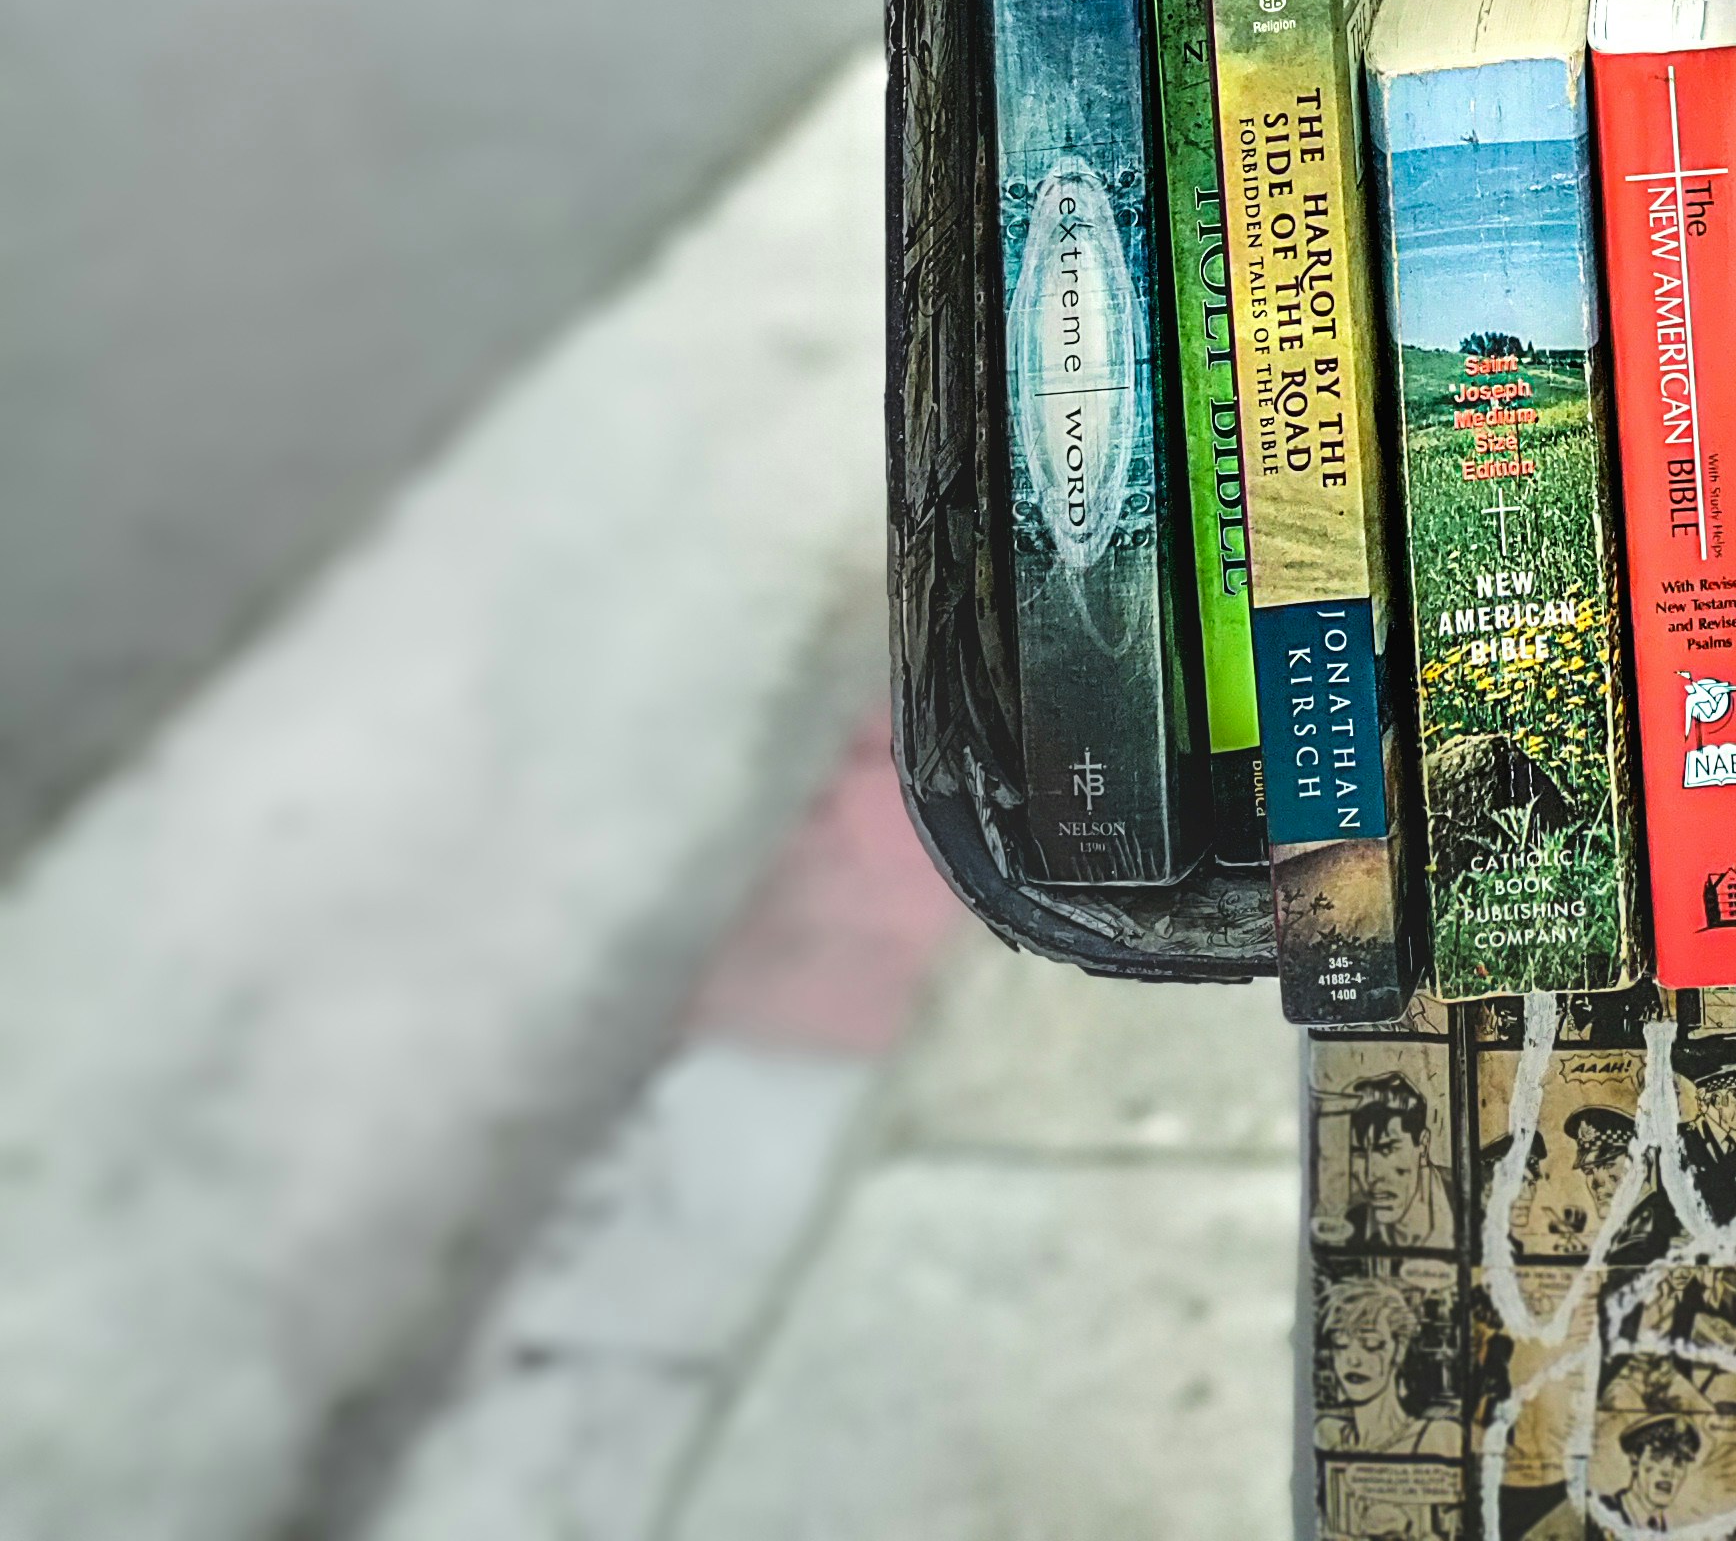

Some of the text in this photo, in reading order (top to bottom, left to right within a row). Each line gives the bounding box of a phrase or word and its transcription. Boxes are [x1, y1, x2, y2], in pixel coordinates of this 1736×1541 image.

[1253, 17, 1296, 35] Religion
[1685, 180, 1715, 237] The
[1239, 117, 1279, 476] FORBIDDEN TALES OF THE BIBLE
[1264, 111, 1313, 473] SIDE OF THE ROAD
[1296, 88, 1346, 488] THE HARLOT BY THE
[1058, 195, 1086, 528] extreme WORD
[1465, 354, 1518, 376] Saint
[1648, 186, 1699, 538] NEW AMERICAN BIBLE
[1454, 380, 1533, 403] Joseph
[1454, 407, 1538, 430] Medium
[1475, 434, 1518, 453] Size
[1462, 458, 1536, 481] Edition
[1708, 453, 1724, 559] With Study Helps
[1477, 572, 1534, 598] NEW
[1661, 579, 1695, 594] With
[1656, 599, 1689, 615] New
[1439, 601, 1577, 637] AMERICAN
[1667, 618, 1694, 632] and
[1471, 636, 1550, 665] BIBLE
[1686, 636, 1732, 651] Psalms
[1288, 647, 1321, 798] KIRSCH
[1317, 609, 1361, 829] JONATHAN
[1059, 822, 1125, 835] NELSON
[1471, 850, 1573, 871] CATHOLIC
[1494, 877, 1555, 895] BOOK
[1465, 902, 1586, 925] PUBLISHING
[1475, 929, 1580, 949] COMPANY
[1329, 956, 1353, 969] 345-
[1318, 972, 1366, 986] 41882-4-
[1330, 988, 1356, 1002] 1400
[1572, 1061, 1632, 1074] AAAH!
